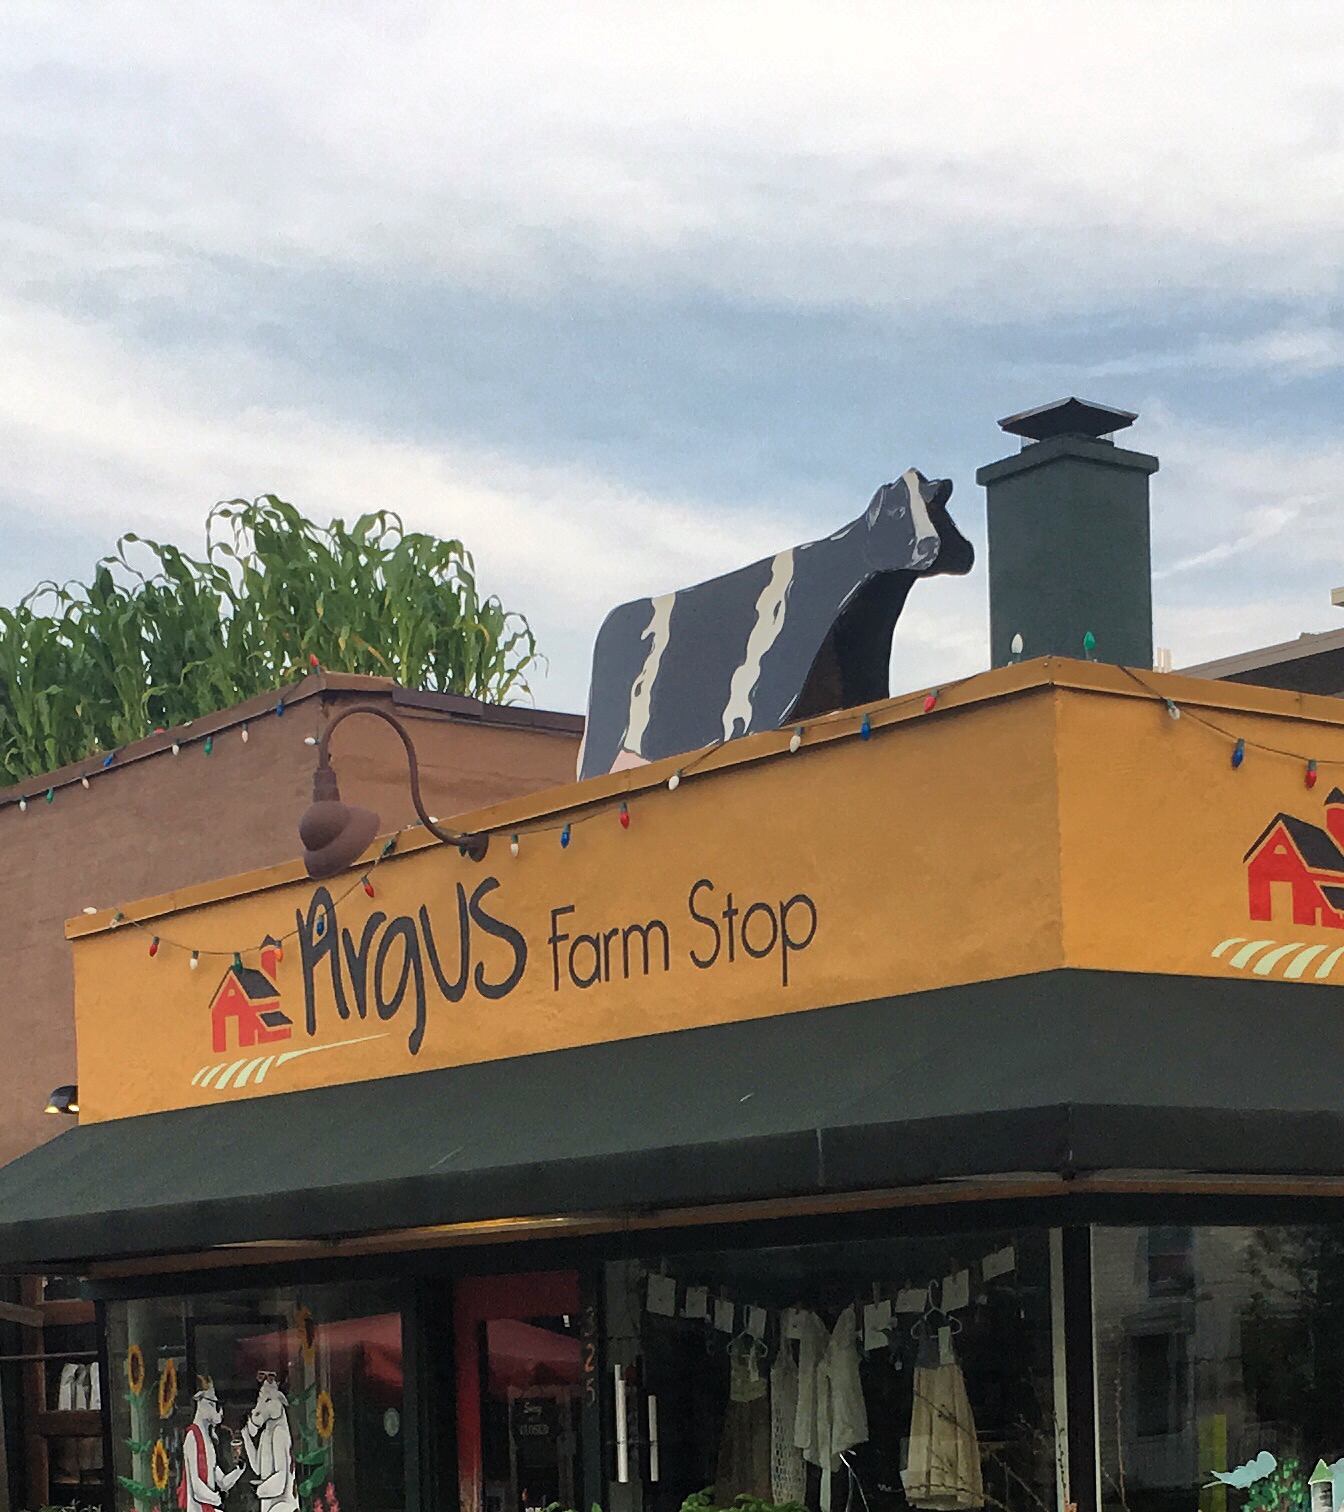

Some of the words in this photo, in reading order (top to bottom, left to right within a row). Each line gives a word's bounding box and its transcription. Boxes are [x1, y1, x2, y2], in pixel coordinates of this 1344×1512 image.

[296, 876, 528, 1055] Argus
[547, 903, 671, 991] Farm
[688, 878, 819, 987] Stop
